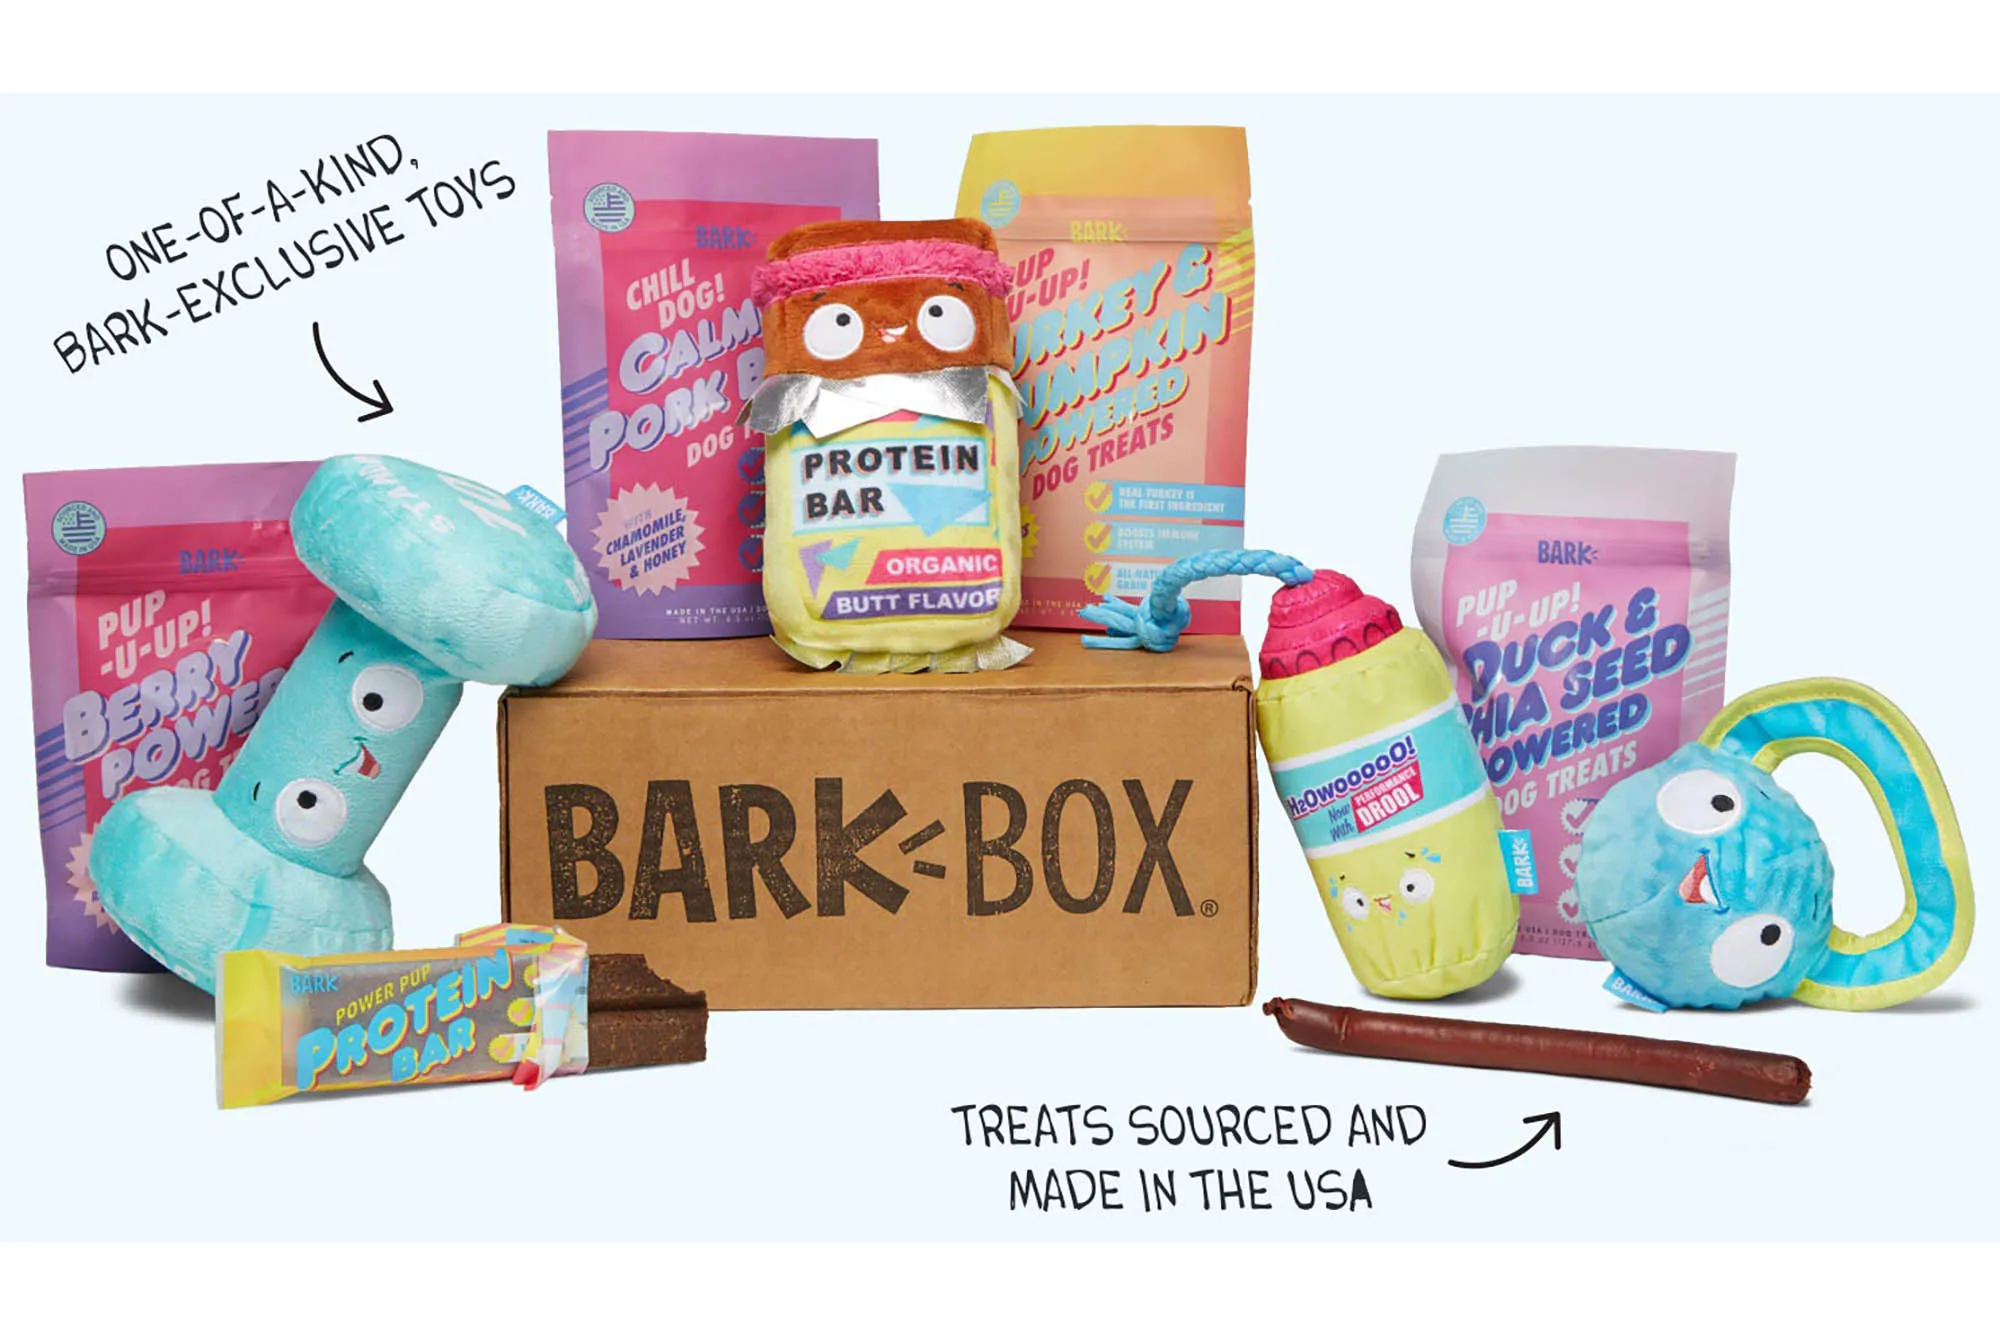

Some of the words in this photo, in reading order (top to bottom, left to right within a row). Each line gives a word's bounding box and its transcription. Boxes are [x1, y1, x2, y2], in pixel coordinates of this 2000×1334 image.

[695, 225, 751, 250] BARK
[1069, 219, 1122, 243] BARK
[626, 258, 695, 311] CHILL
[1016, 247, 1055, 288] UP
[658, 272, 725, 330] DOG!
[1007, 258, 1090, 323] U-UP!
[1020, 291, 1232, 431] UMPKIN
[589, 370, 731, 472] PORK
[1021, 366, 1190, 478] POWERED
[687, 425, 734, 468] DOG
[803, 444, 980, 481] PROTEIN
[1032, 456, 1079, 502] DOG
[1087, 413, 1174, 472] TREATS
[804, 486, 885, 520] BAR
[1118, 486, 1143, 498] REAL
[1145, 487, 1184, 500] TURKEY
[1186, 489, 1195, 500] IS
[1119, 499, 1136, 510] THE
[1138, 500, 1165, 512] FIRST
[1167, 501, 1225, 514] INGREDIENT
[606, 508, 686, 555] CHAMOMILE,
[624, 508, 652, 530] WITH
[1118, 527, 1155, 538] BOOSTS
[1157, 528, 1199, 541] IMMUNE
[178, 548, 239, 575] BARK
[620, 525, 684, 567] LAVENDER
[629, 564, 639, 579] &
[644, 540, 686, 573] HONEY
[886, 553, 998, 576] ORGANIC
[1538, 540, 1592, 566] BARK
[836, 594, 900, 615] BUTT
[908, 587, 1000, 610] FLAVOR
[1116, 579, 1147, 590] GRAIN
[1456, 579, 1517, 628] PUP
[98, 589, 167, 650] PUP
[665, 608, 691, 616] MADE
[696, 608, 705, 616] IN
[710, 607, 727, 615] THE
[1476, 581, 1581, 642] -U-UP!
[100, 598, 212, 680] -U-UP!
[1463, 604, 1616, 706] DUCK
[1624, 586, 1661, 636] &
[1560, 623, 1693, 713] SEED
[62, 629, 254, 764] BERRY
[101, 666, 288, 801] POWER
[1484, 693, 1652, 785] OWERED
[1354, 766, 1416, 806] PERFORMANCE
[1546, 740, 1637, 799] TREATS
[1328, 803, 1350, 824] Now
[1356, 783, 1420, 827] DROOL
[544, 776, 910, 923] BARK
[962, 778, 1195, 918] BOX
[1512, 842, 1534, 887] BARK
[290, 972, 340, 995] BARK
[336, 982, 394, 1026] POWER
[400, 964, 431, 993] PUP
[297, 948, 512, 1092] PROTEIN
[391, 1017, 476, 1084] BAR
